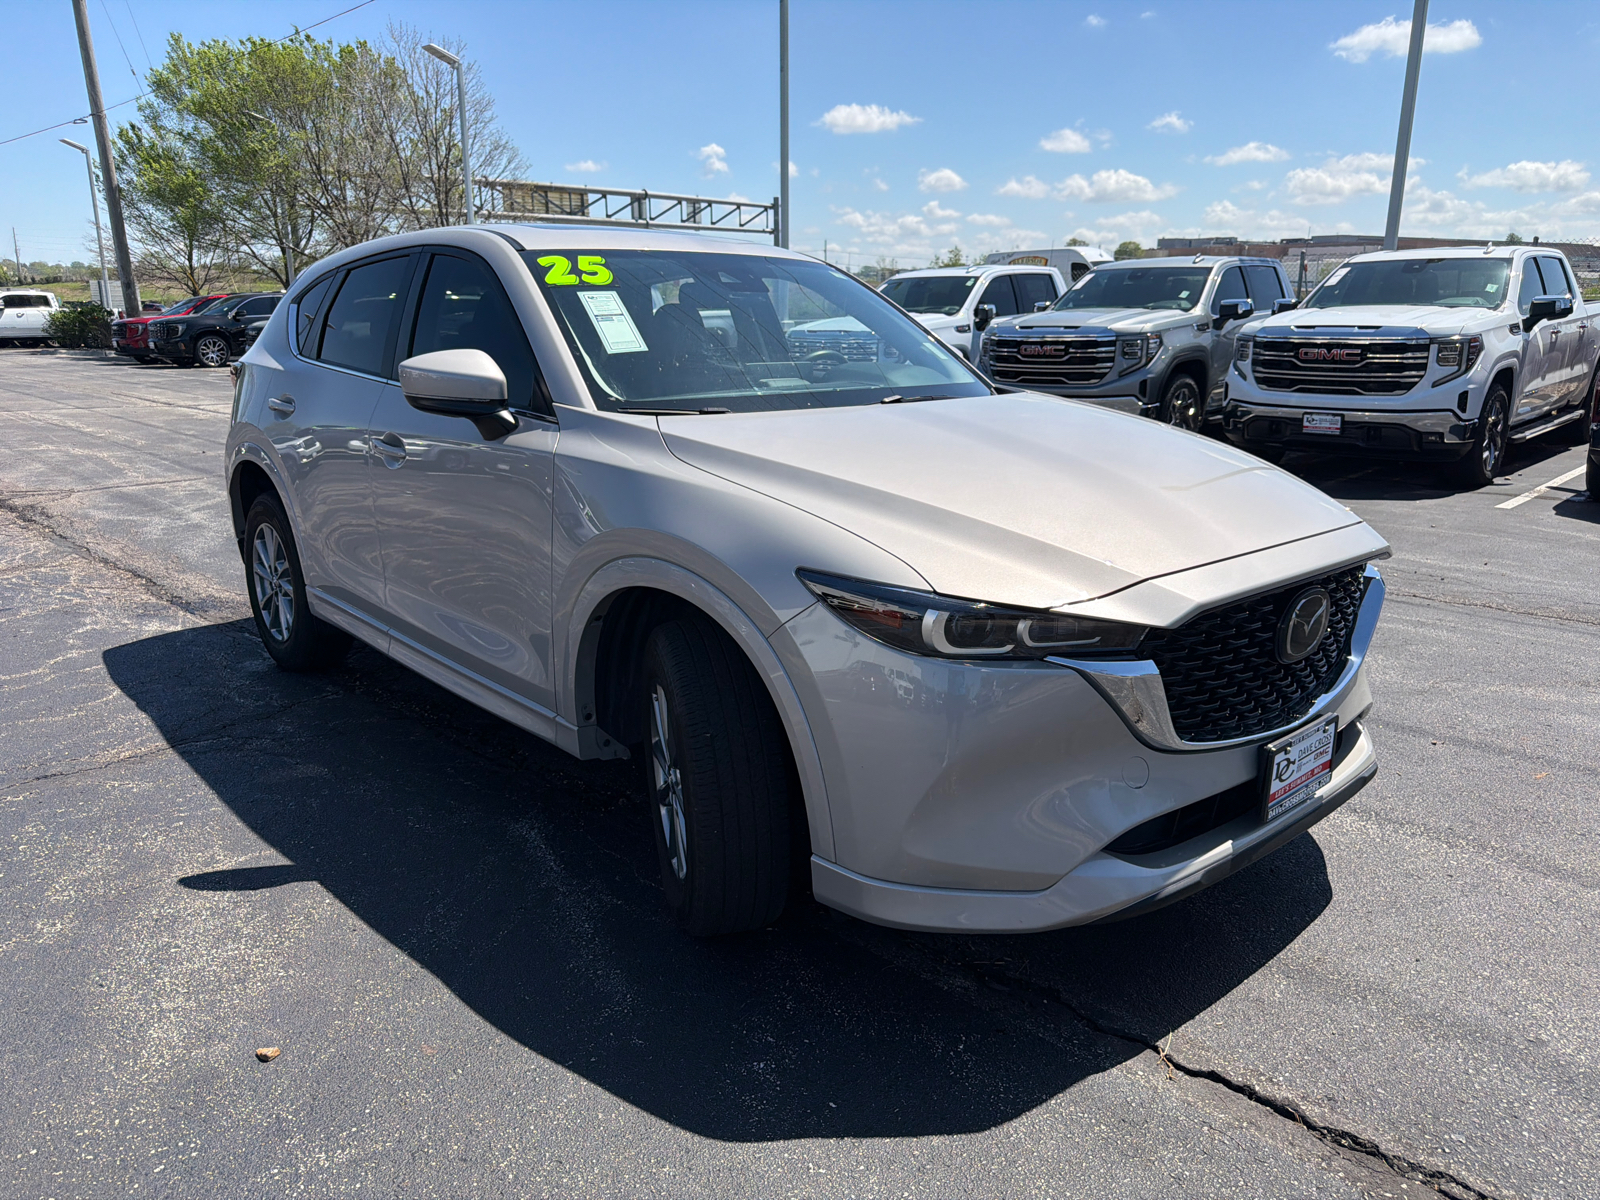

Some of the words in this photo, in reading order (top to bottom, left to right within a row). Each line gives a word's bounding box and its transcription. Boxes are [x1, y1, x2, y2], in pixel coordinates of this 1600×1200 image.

[537, 255, 614, 286] 25
[1020, 345, 1065, 355] GMC
[1299, 348, 1361, 360] GMC
[1298, 742, 1313, 759] DAVE
[1314, 732, 1333, 749] CROSS
[1314, 746, 1330, 760] GMC
[1314, 765, 1323, 775] MO
